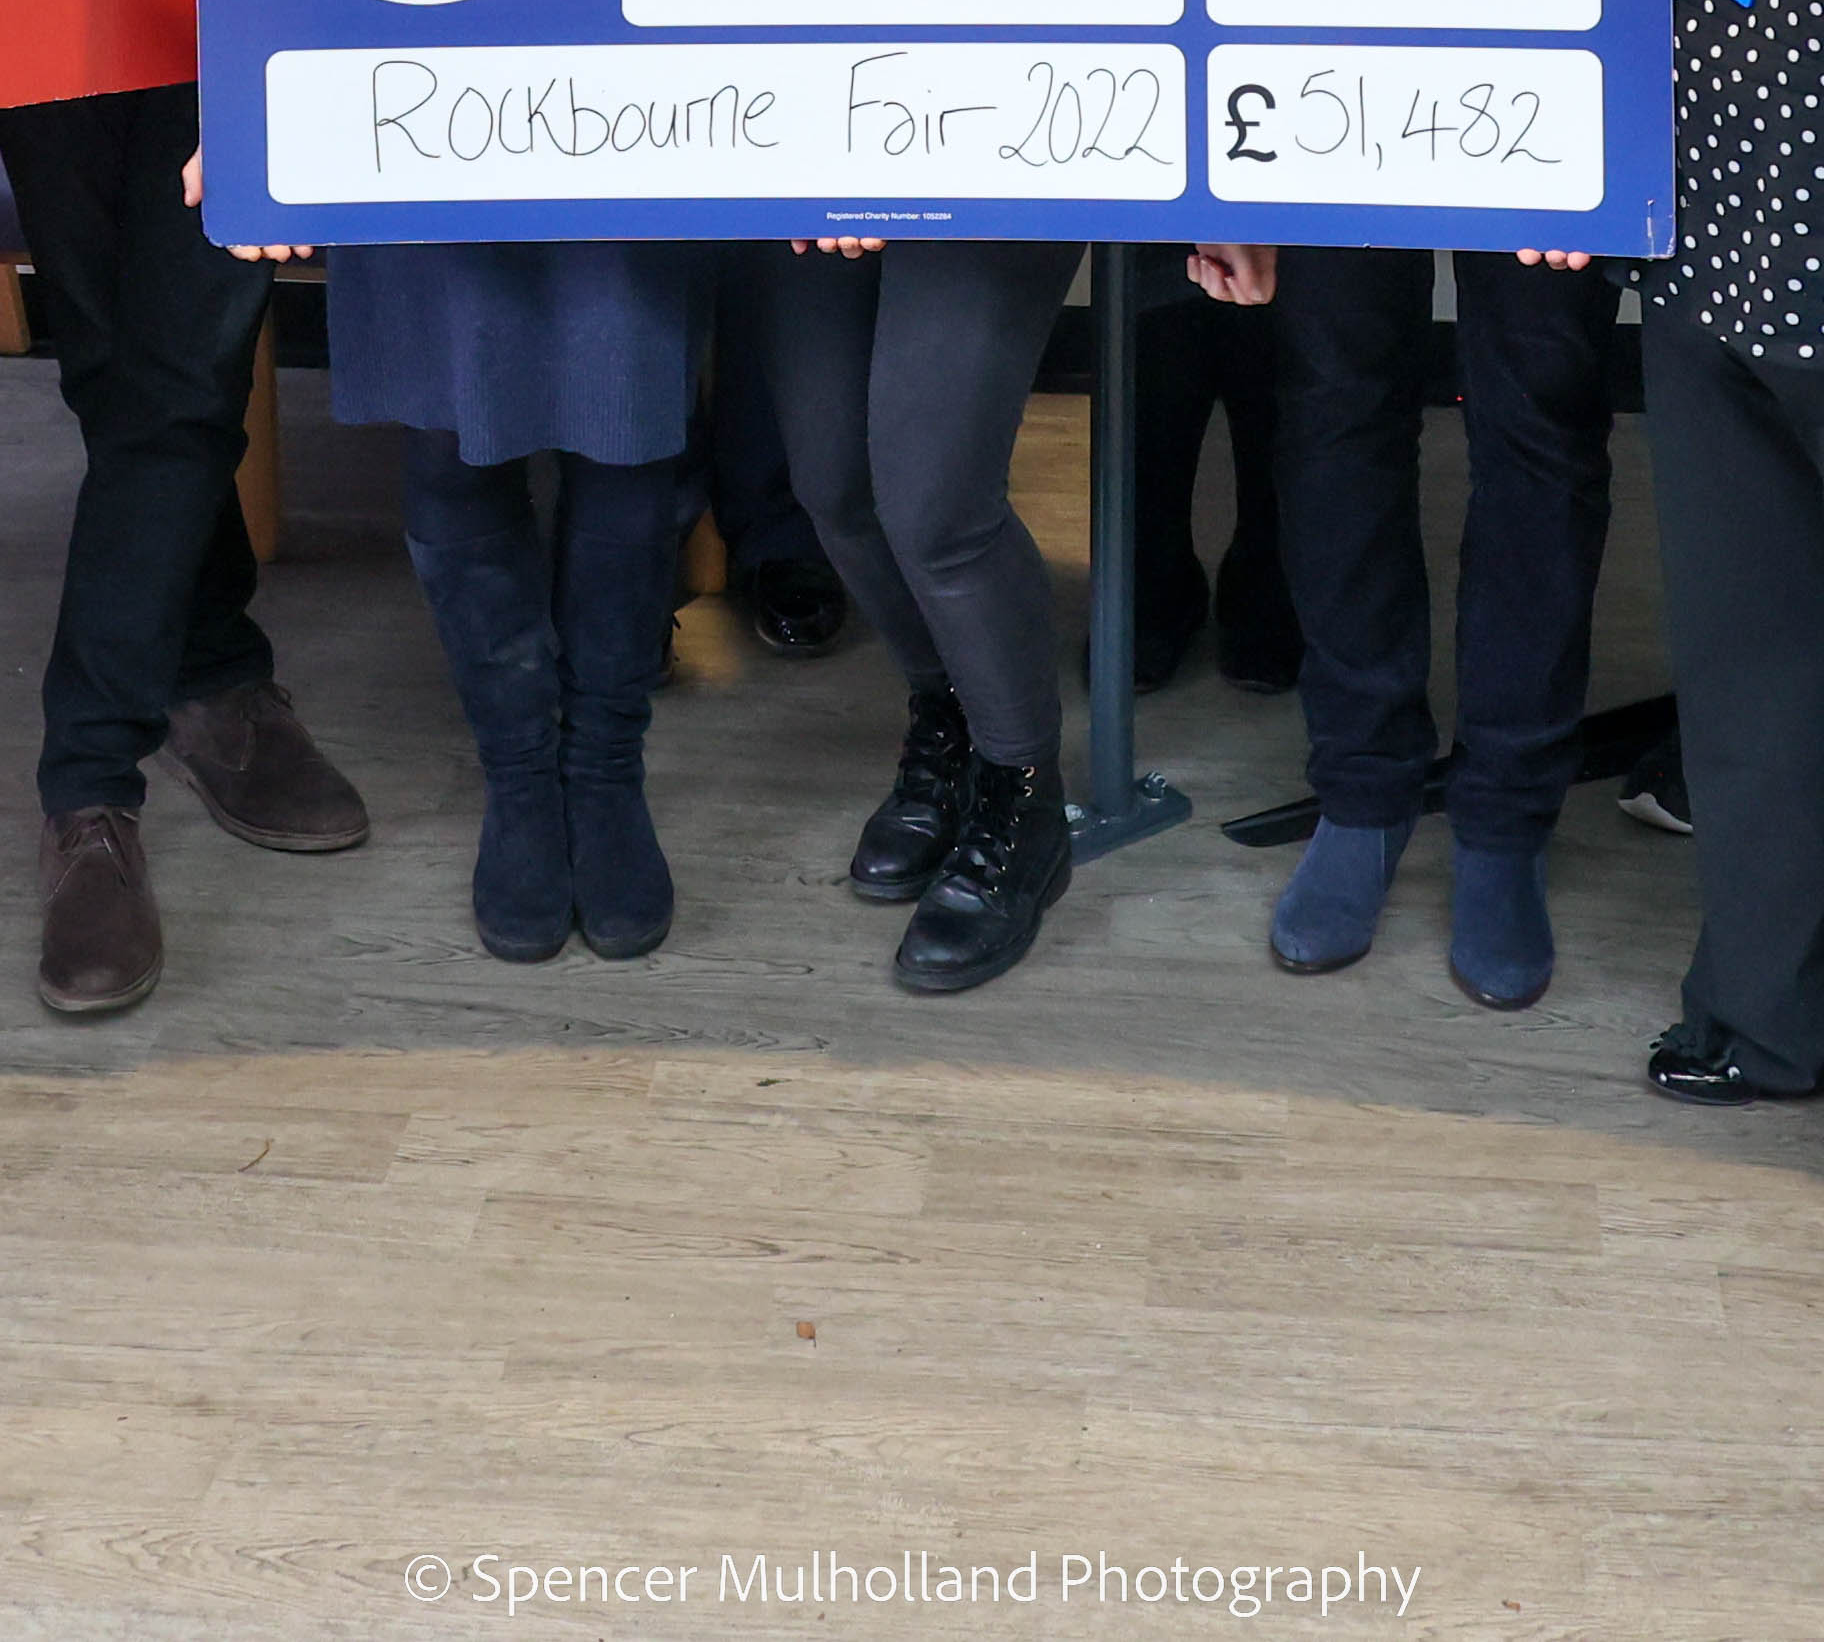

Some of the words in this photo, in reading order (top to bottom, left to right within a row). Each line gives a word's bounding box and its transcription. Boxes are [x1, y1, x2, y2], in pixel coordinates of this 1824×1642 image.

[371, 60, 780, 174] Rockbourne
[847, 50, 998, 156] Fair
[998, 60, 1176, 168] 2022
[826, 211, 864, 222] Registered
[865, 211, 890, 222] Charity
